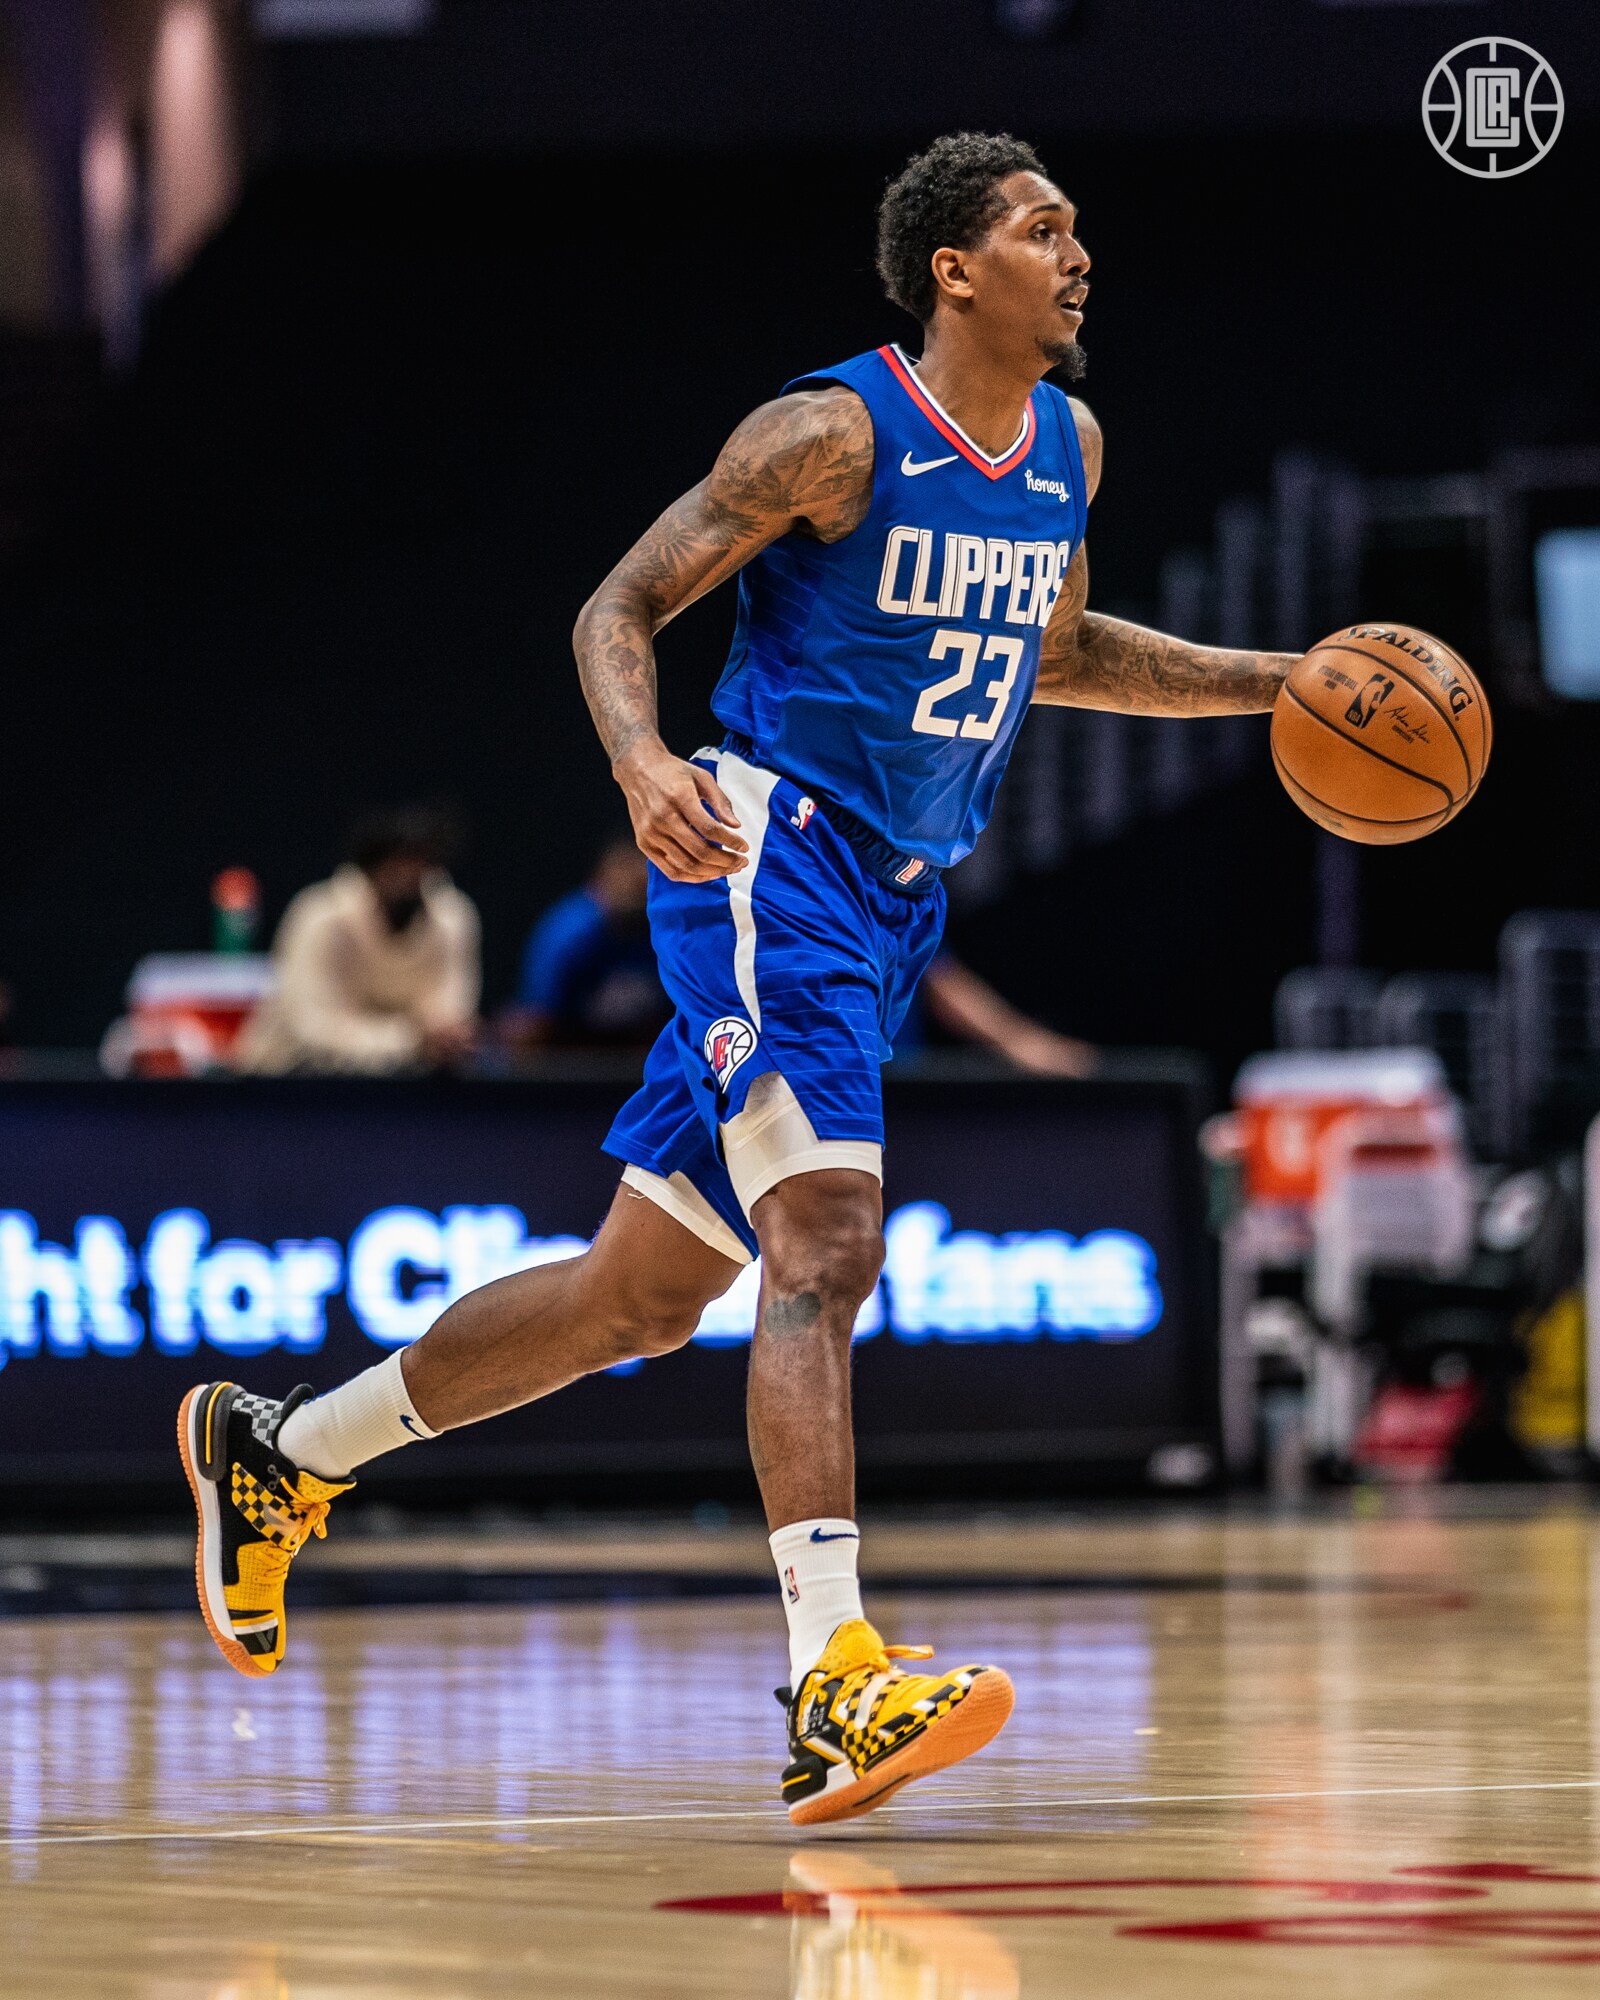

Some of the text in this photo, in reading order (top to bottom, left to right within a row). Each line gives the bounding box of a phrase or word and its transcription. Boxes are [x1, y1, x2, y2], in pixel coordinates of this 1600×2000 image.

[1025, 469, 1069, 502] honey
[877, 525, 1069, 628] CLIPPERS
[912, 629, 1024, 741] 23
[1338, 627, 1473, 714] SPALDING
[0, 1209, 144, 1371] ht
[141, 1207, 345, 1357] for
